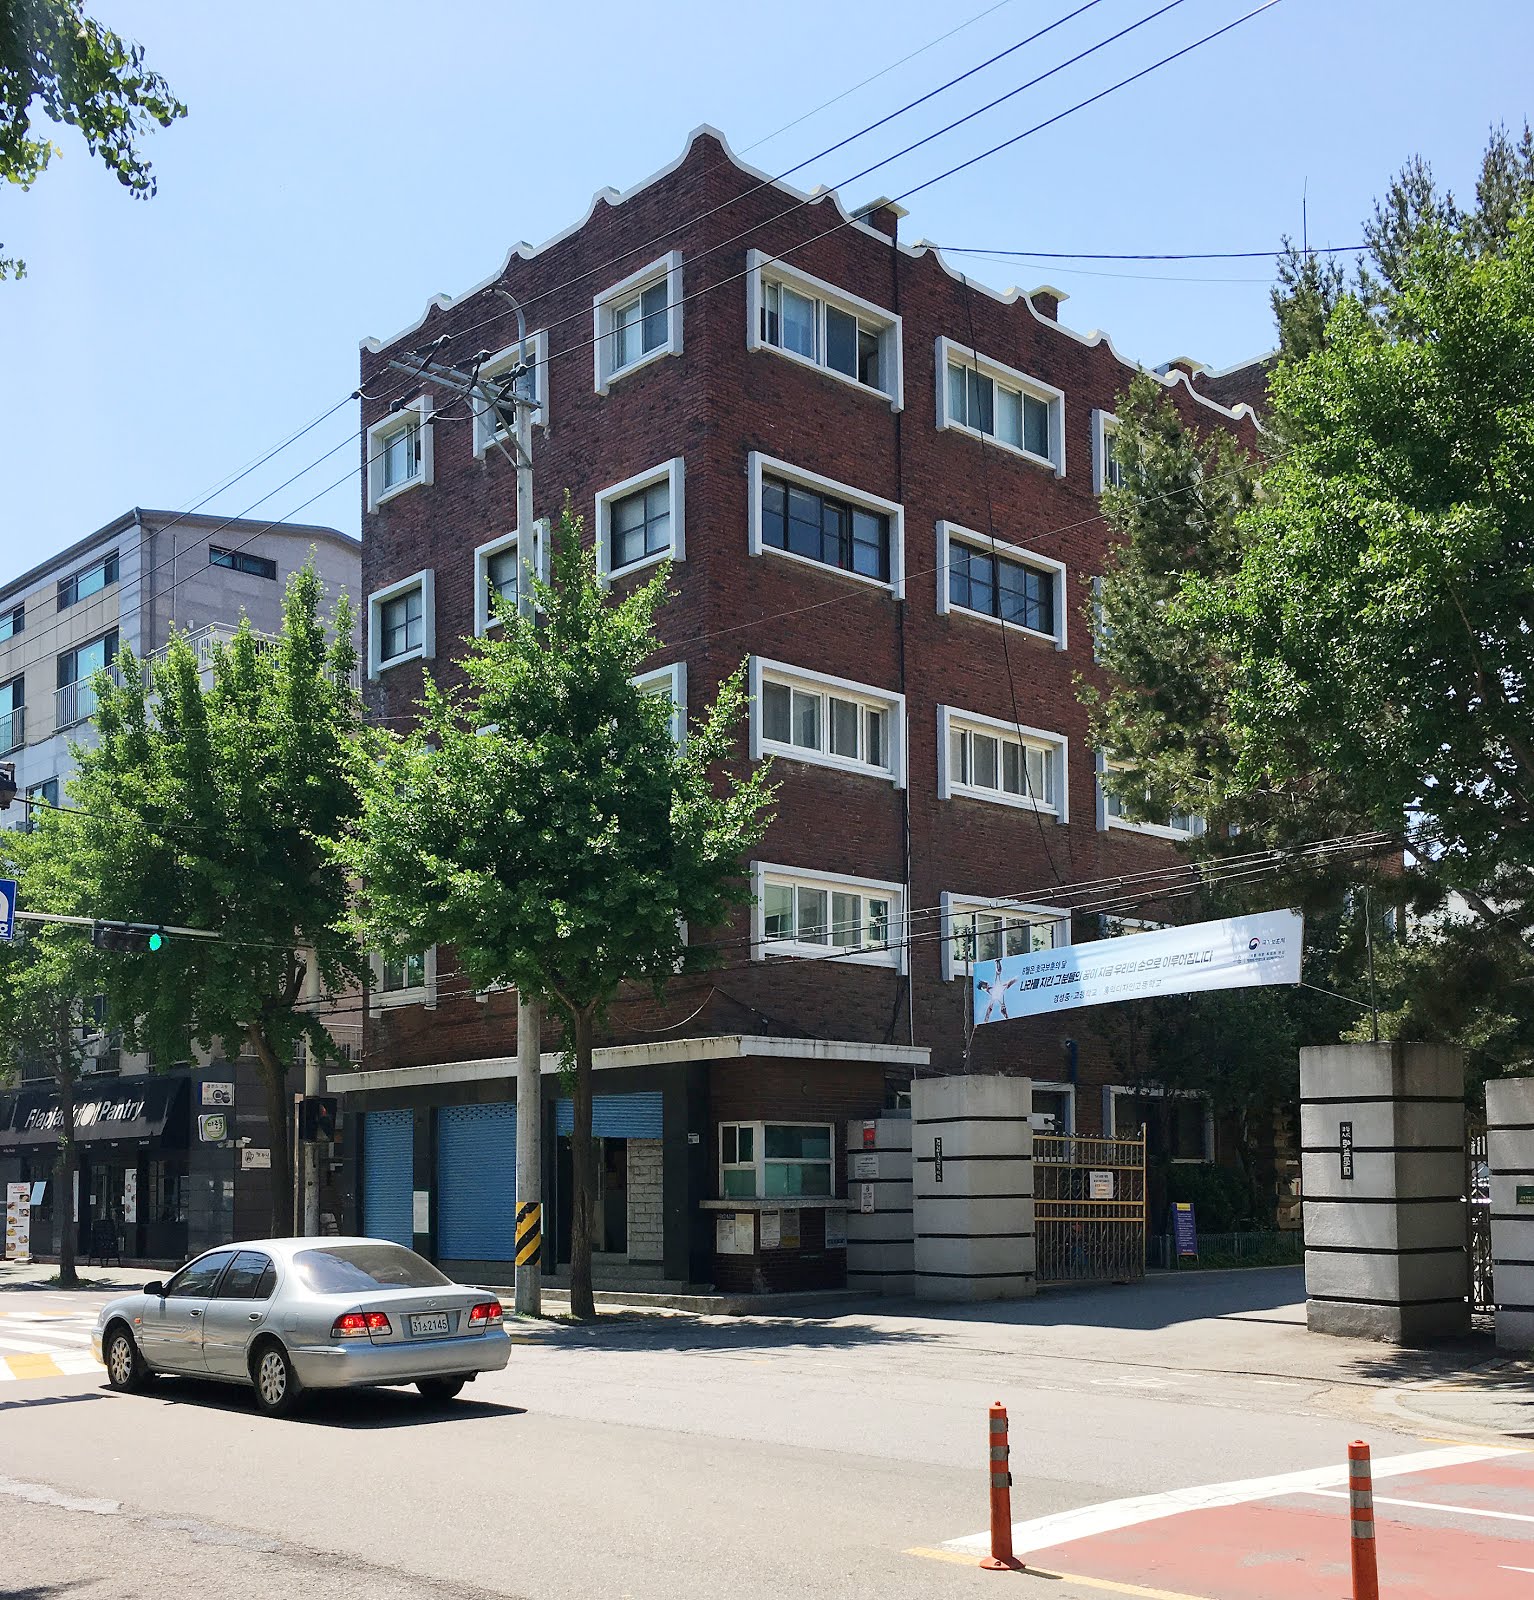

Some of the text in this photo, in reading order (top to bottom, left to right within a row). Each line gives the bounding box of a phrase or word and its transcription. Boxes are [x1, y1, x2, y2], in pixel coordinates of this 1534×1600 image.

[1020, 950, 1214, 992] 나라를 지킨 그분들의 꿈이 지금 우리의 손으로 이루어집니다
[24, 1099, 145, 1130] Flapjak Pantry
